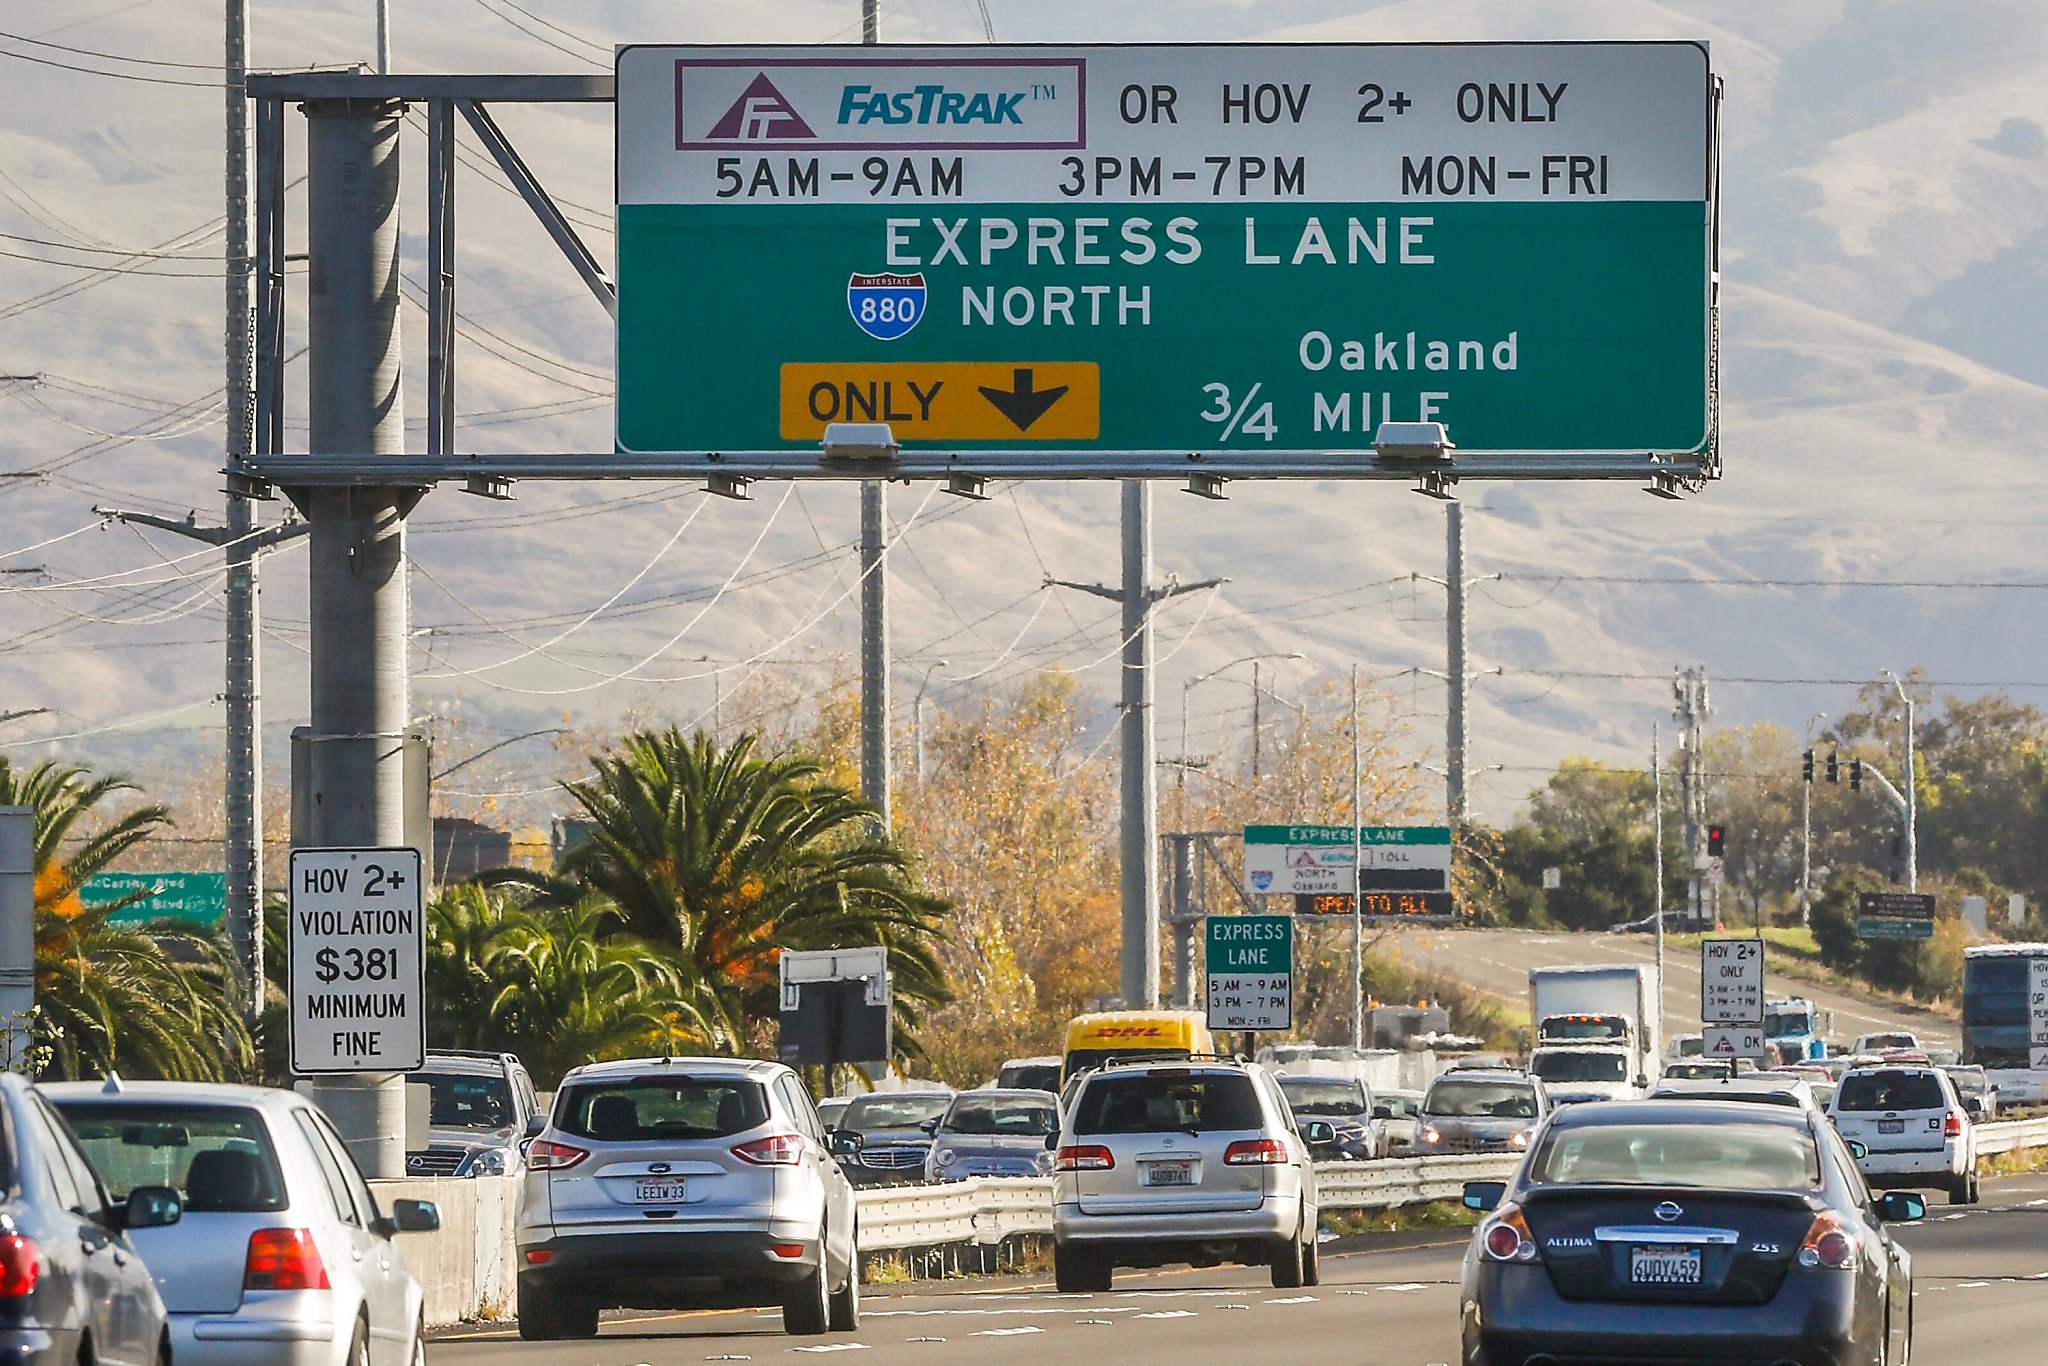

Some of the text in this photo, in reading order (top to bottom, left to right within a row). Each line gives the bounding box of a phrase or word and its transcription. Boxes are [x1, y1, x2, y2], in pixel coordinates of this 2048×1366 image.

[1120, 84, 1178, 124] OR
[1222, 84, 1311, 124] HOV
[1357, 83, 1413, 124] 2+
[1456, 82, 1568, 122] ONLY
[886, 216, 1436, 265] EXPRESS LANE
[862, 278, 912, 286] INTERSTATE
[860, 286, 1151, 326] 880 NORTH
[1299, 332, 1517, 371] Oakland
[808, 381, 944, 421] ONLY
[1288, 829, 1405, 841] EXPRESS LANE
[1379, 852, 1410, 863] TOLL
[304, 864, 405, 897] HOV 2+
[1295, 869, 1336, 879] NORTH
[1365, 895, 1391, 914] TO
[300, 910, 413, 936] VIOLATION
[1214, 924, 1284, 940] EXPRESS
[1228, 948, 1268, 965] LANE
[1708, 944, 1756, 960] HOV 2+
[315, 946, 397, 985] $381
[1720, 965, 1744, 978] ONLY
[1211, 981, 1219, 992] 5
[1224, 980, 1240, 992] AM
[1258, 979, 1266, 991] 9
[1270, 979, 1287, 991] AM
[308, 994, 405, 1019] MINIMUM
[1213, 998, 1221, 1008] 3
[1225, 998, 1241, 1008] PM
[1258, 997, 1265, 1008] 7
[1270, 997, 1285, 1008] PM
[1227, 1017, 1246, 1026] MON
[1097, 1027, 1161, 1038] DHL
[333, 1031, 381, 1056] FINE
[1744, 1036, 1760, 1048] OK
[1547, 1238, 1593, 1247] ALTIMA
[1632, 1275, 1700, 1283] BOARDWALK
